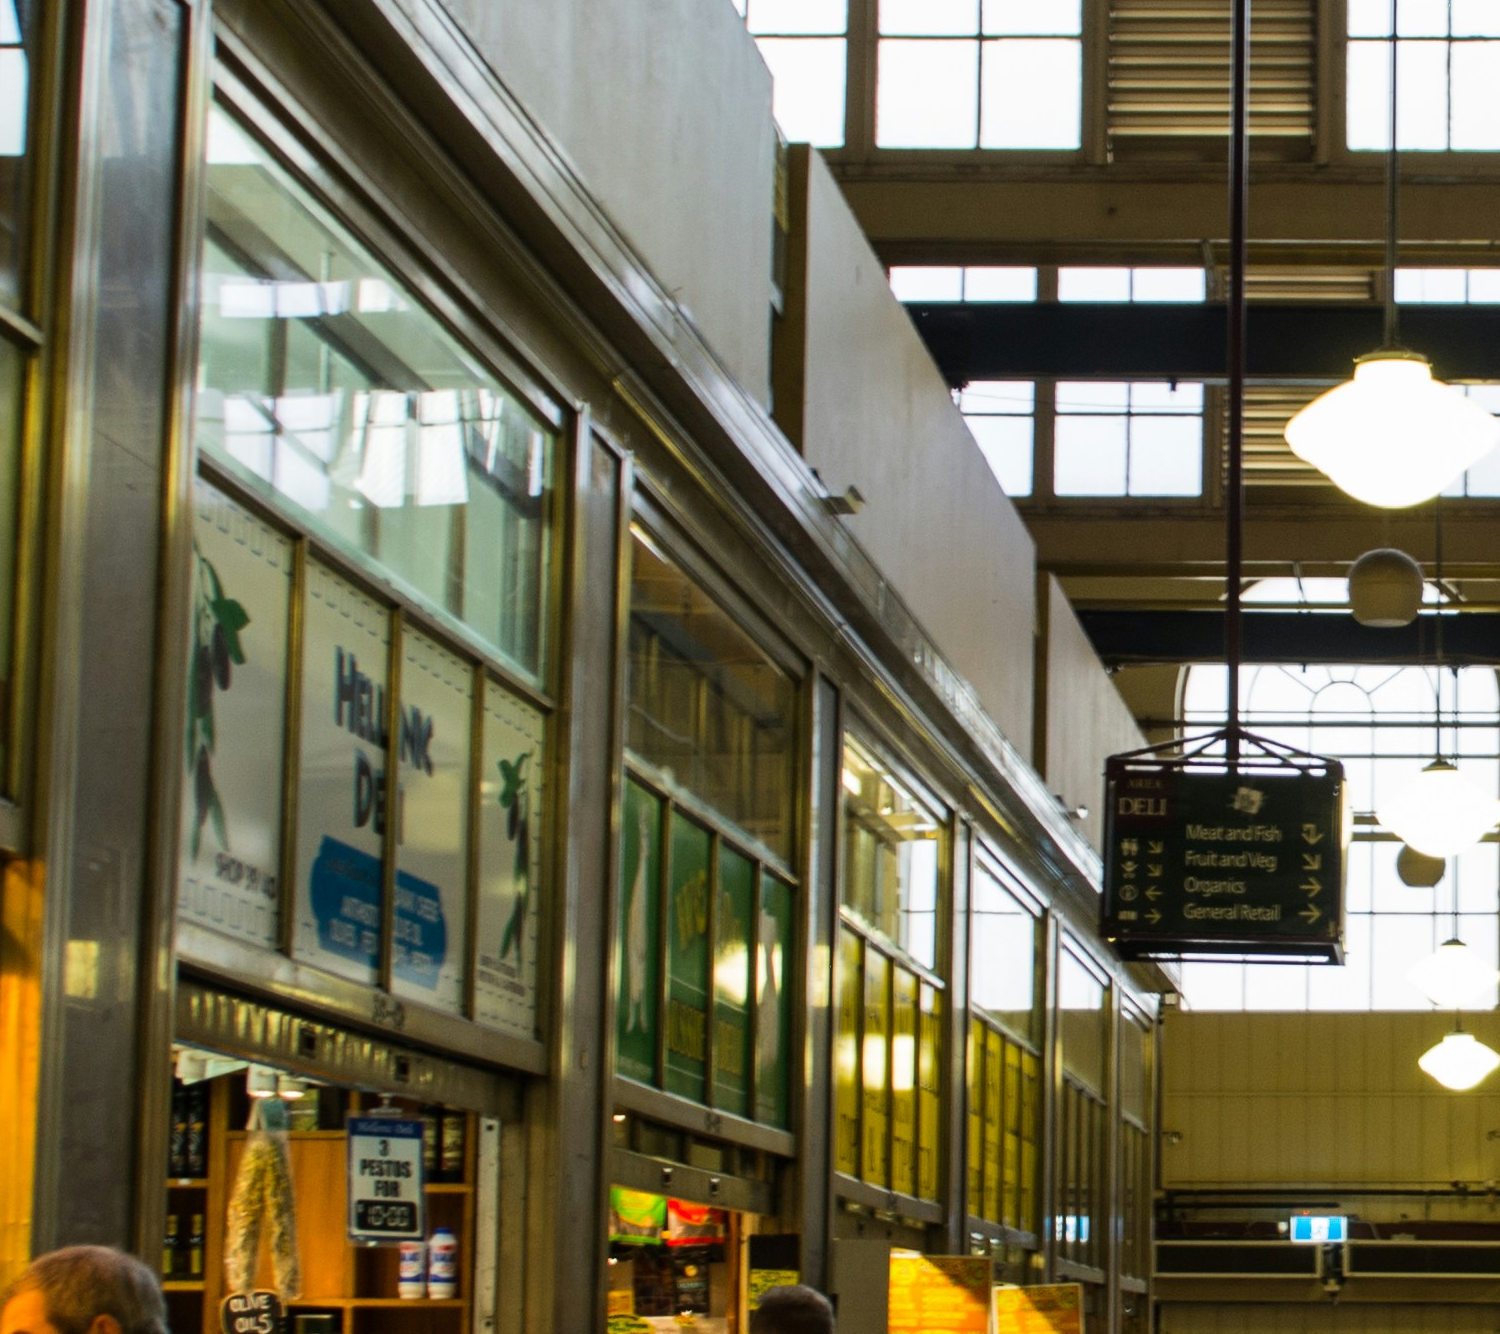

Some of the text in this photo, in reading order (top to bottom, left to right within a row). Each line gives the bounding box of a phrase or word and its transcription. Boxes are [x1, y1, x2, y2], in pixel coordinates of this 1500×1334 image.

[1118, 797, 1167, 816] DELI
[1185, 824, 1282, 842] Meat and Fish
[1184, 850, 1278, 872] Fruit and Veg
[1184, 876, 1247, 897] Organics
[1183, 902, 1282, 922] General Retail
[379, 1139, 389, 1157] 3
[360, 1158, 412, 1179] PESTOS
[374, 1180, 400, 1198] FOR
[229, 1294, 271, 1313] OLIVE
[235, 1313, 274, 1334] OILS
